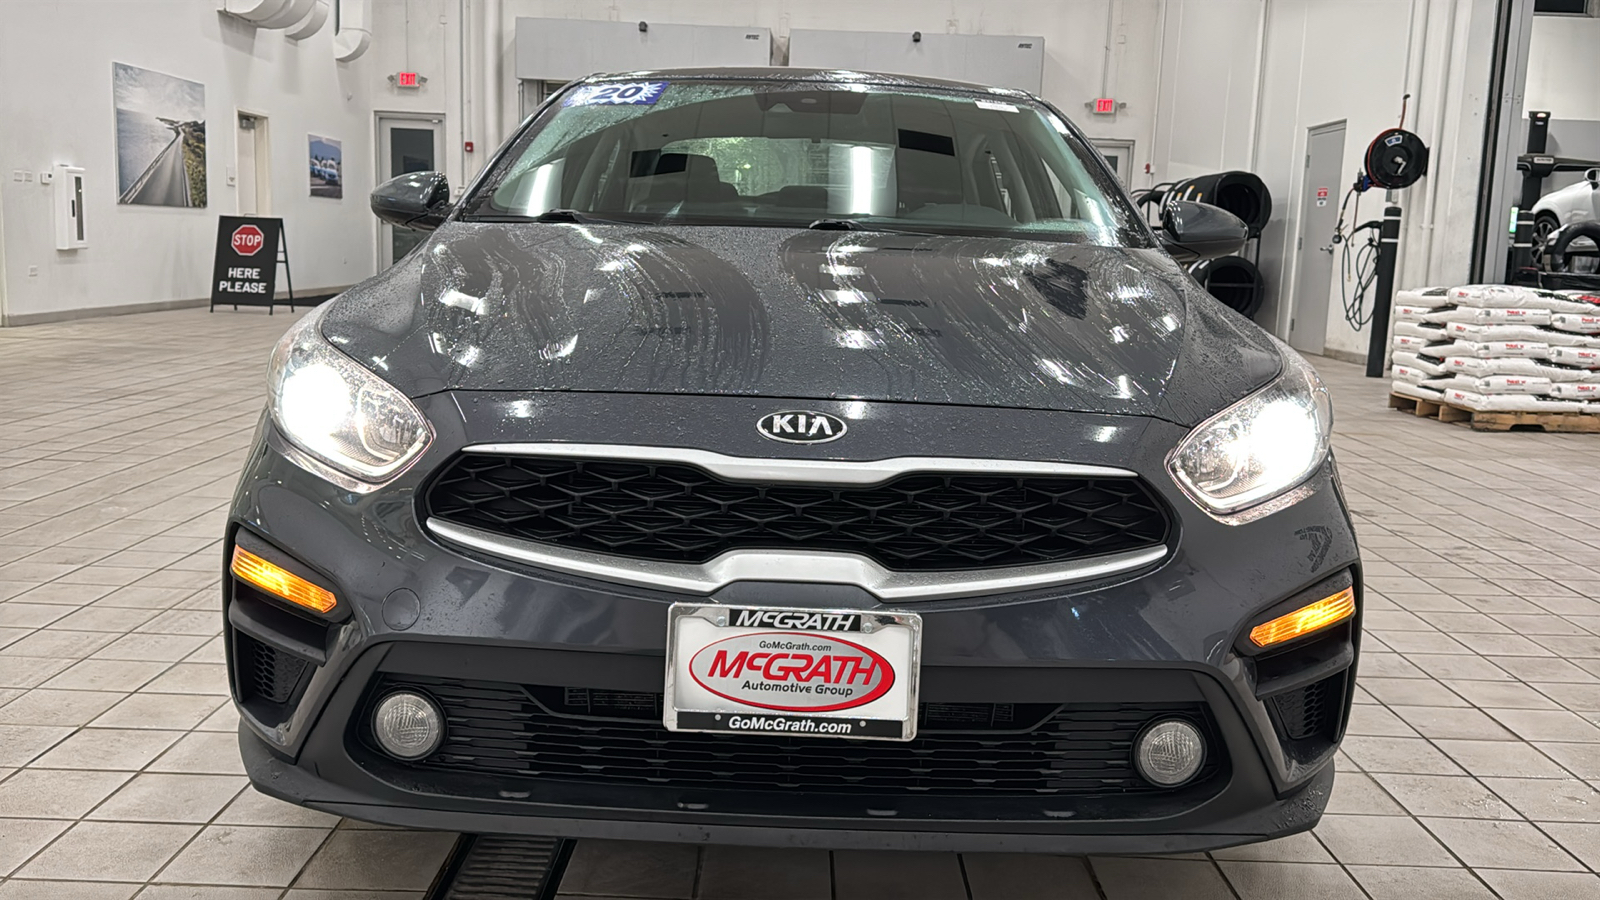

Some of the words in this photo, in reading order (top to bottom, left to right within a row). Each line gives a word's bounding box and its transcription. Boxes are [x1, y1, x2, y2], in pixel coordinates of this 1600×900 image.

[400, 73, 416, 85] EXIT
[592, 87, 643, 100] 20
[1097, 99, 1113, 112] EXIT
[234, 234, 260, 246] STOP
[228, 267, 260, 279] HERE
[218, 281, 267, 293] PLEASE
[773, 415, 833, 435] KIA
[759, 640, 832, 652] GoMcGrath.com
[741, 680, 812, 694] Automotive
[815, 684, 853, 698] Group
[728, 716, 852, 734] GoMcGrath.com
